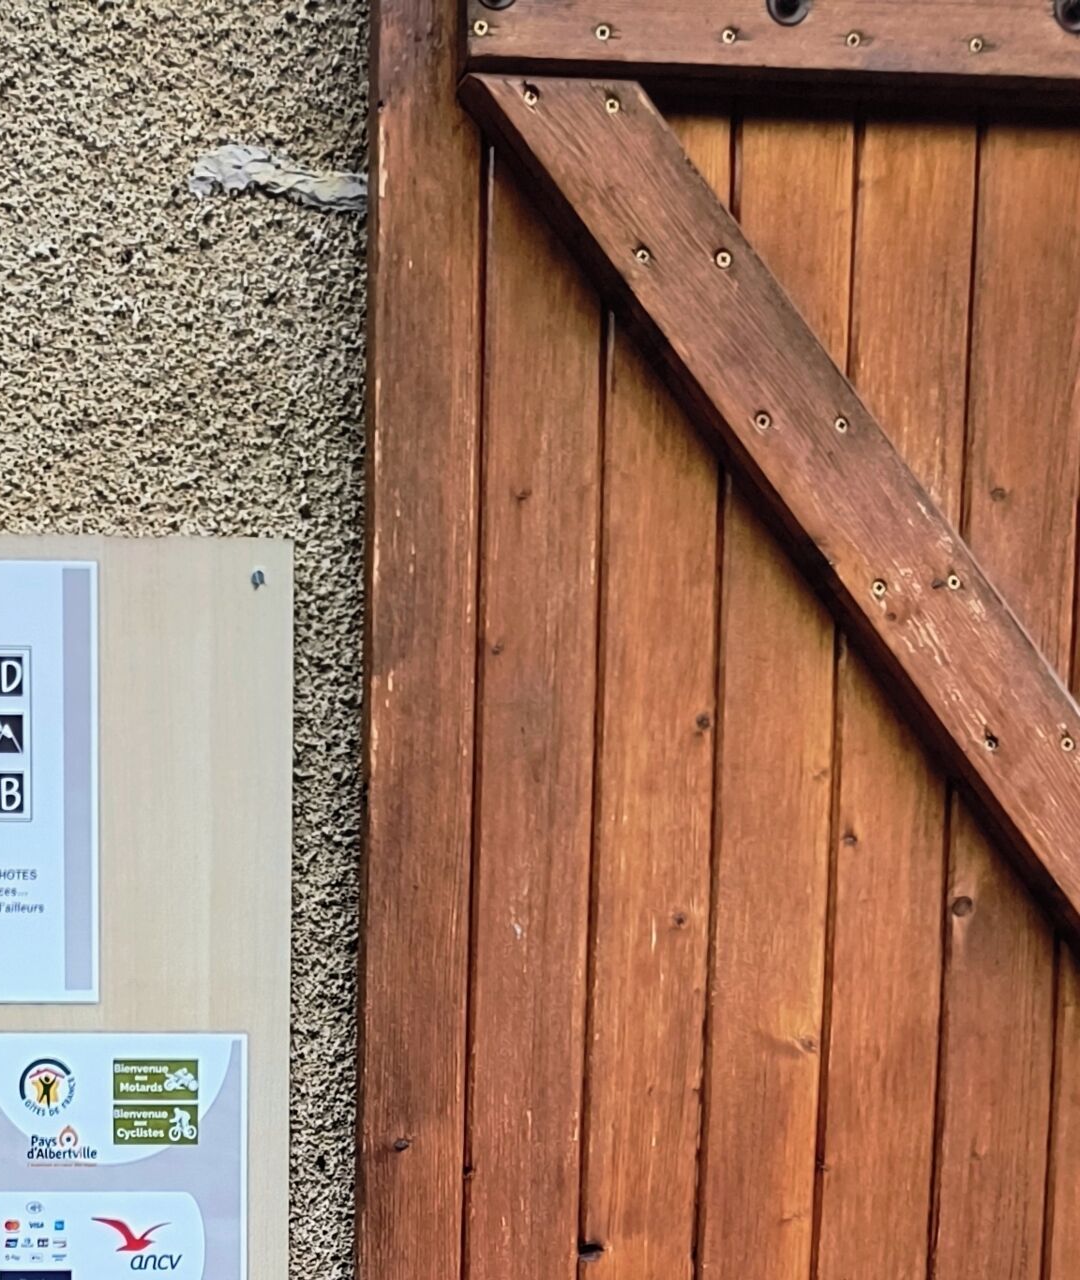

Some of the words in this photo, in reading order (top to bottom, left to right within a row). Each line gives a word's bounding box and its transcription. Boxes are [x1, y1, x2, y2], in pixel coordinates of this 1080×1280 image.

[114, 1063, 168, 1075] Bienvenue
[119, 1082, 163, 1094] Motards
[113, 1108, 168, 1120] Bienvenue
[116, 1127, 165, 1140] Cyclistes
[30, 1134, 58, 1149] Pays
[26, 1147, 98, 1161] d'Albertville
[130, 1254, 182, 1271] ancv
